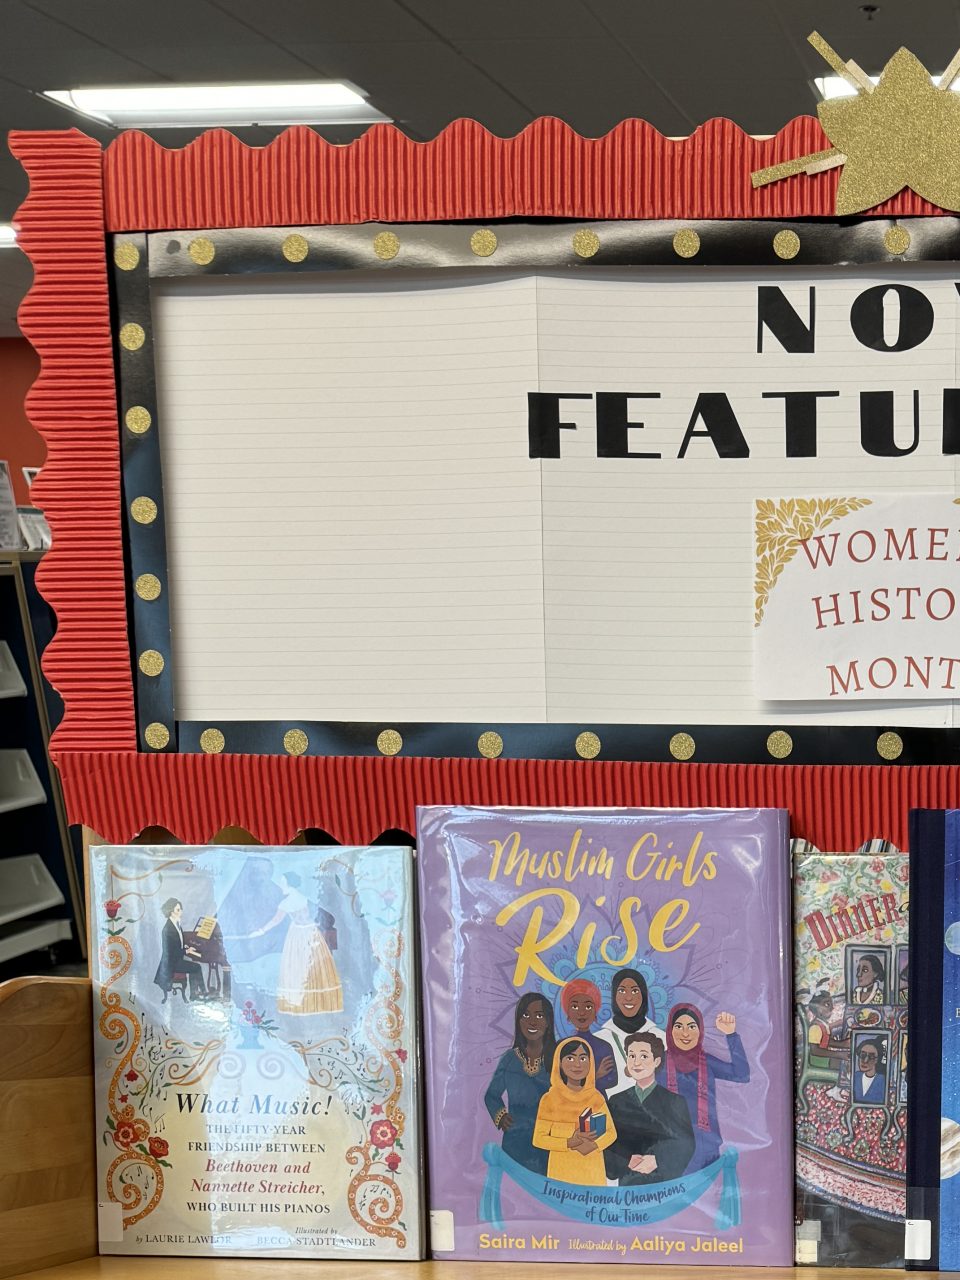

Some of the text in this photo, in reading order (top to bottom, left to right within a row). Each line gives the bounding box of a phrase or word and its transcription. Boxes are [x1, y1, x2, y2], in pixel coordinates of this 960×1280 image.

[489, 829, 718, 887] Muslim Girls
[496, 888, 700, 988] Rise
[176, 1093, 332, 1116] What Music!
[188, 1142, 326, 1153] FRIENDSHIP BETWEEN
[205, 1159, 311, 1174] Beethoven and
[191, 1178, 325, 1196] Nannette Streicher,
[541, 1180, 685, 1205] Inspirational Champions
[187, 1202, 330, 1214] WHO BUILT HIS PIANOS
[621, 1210, 649, 1223] Time
[146, 1234, 185, 1244] LAURIE
[479, 1234, 743, 1255] Saira Mir Aaliya Jaleel
